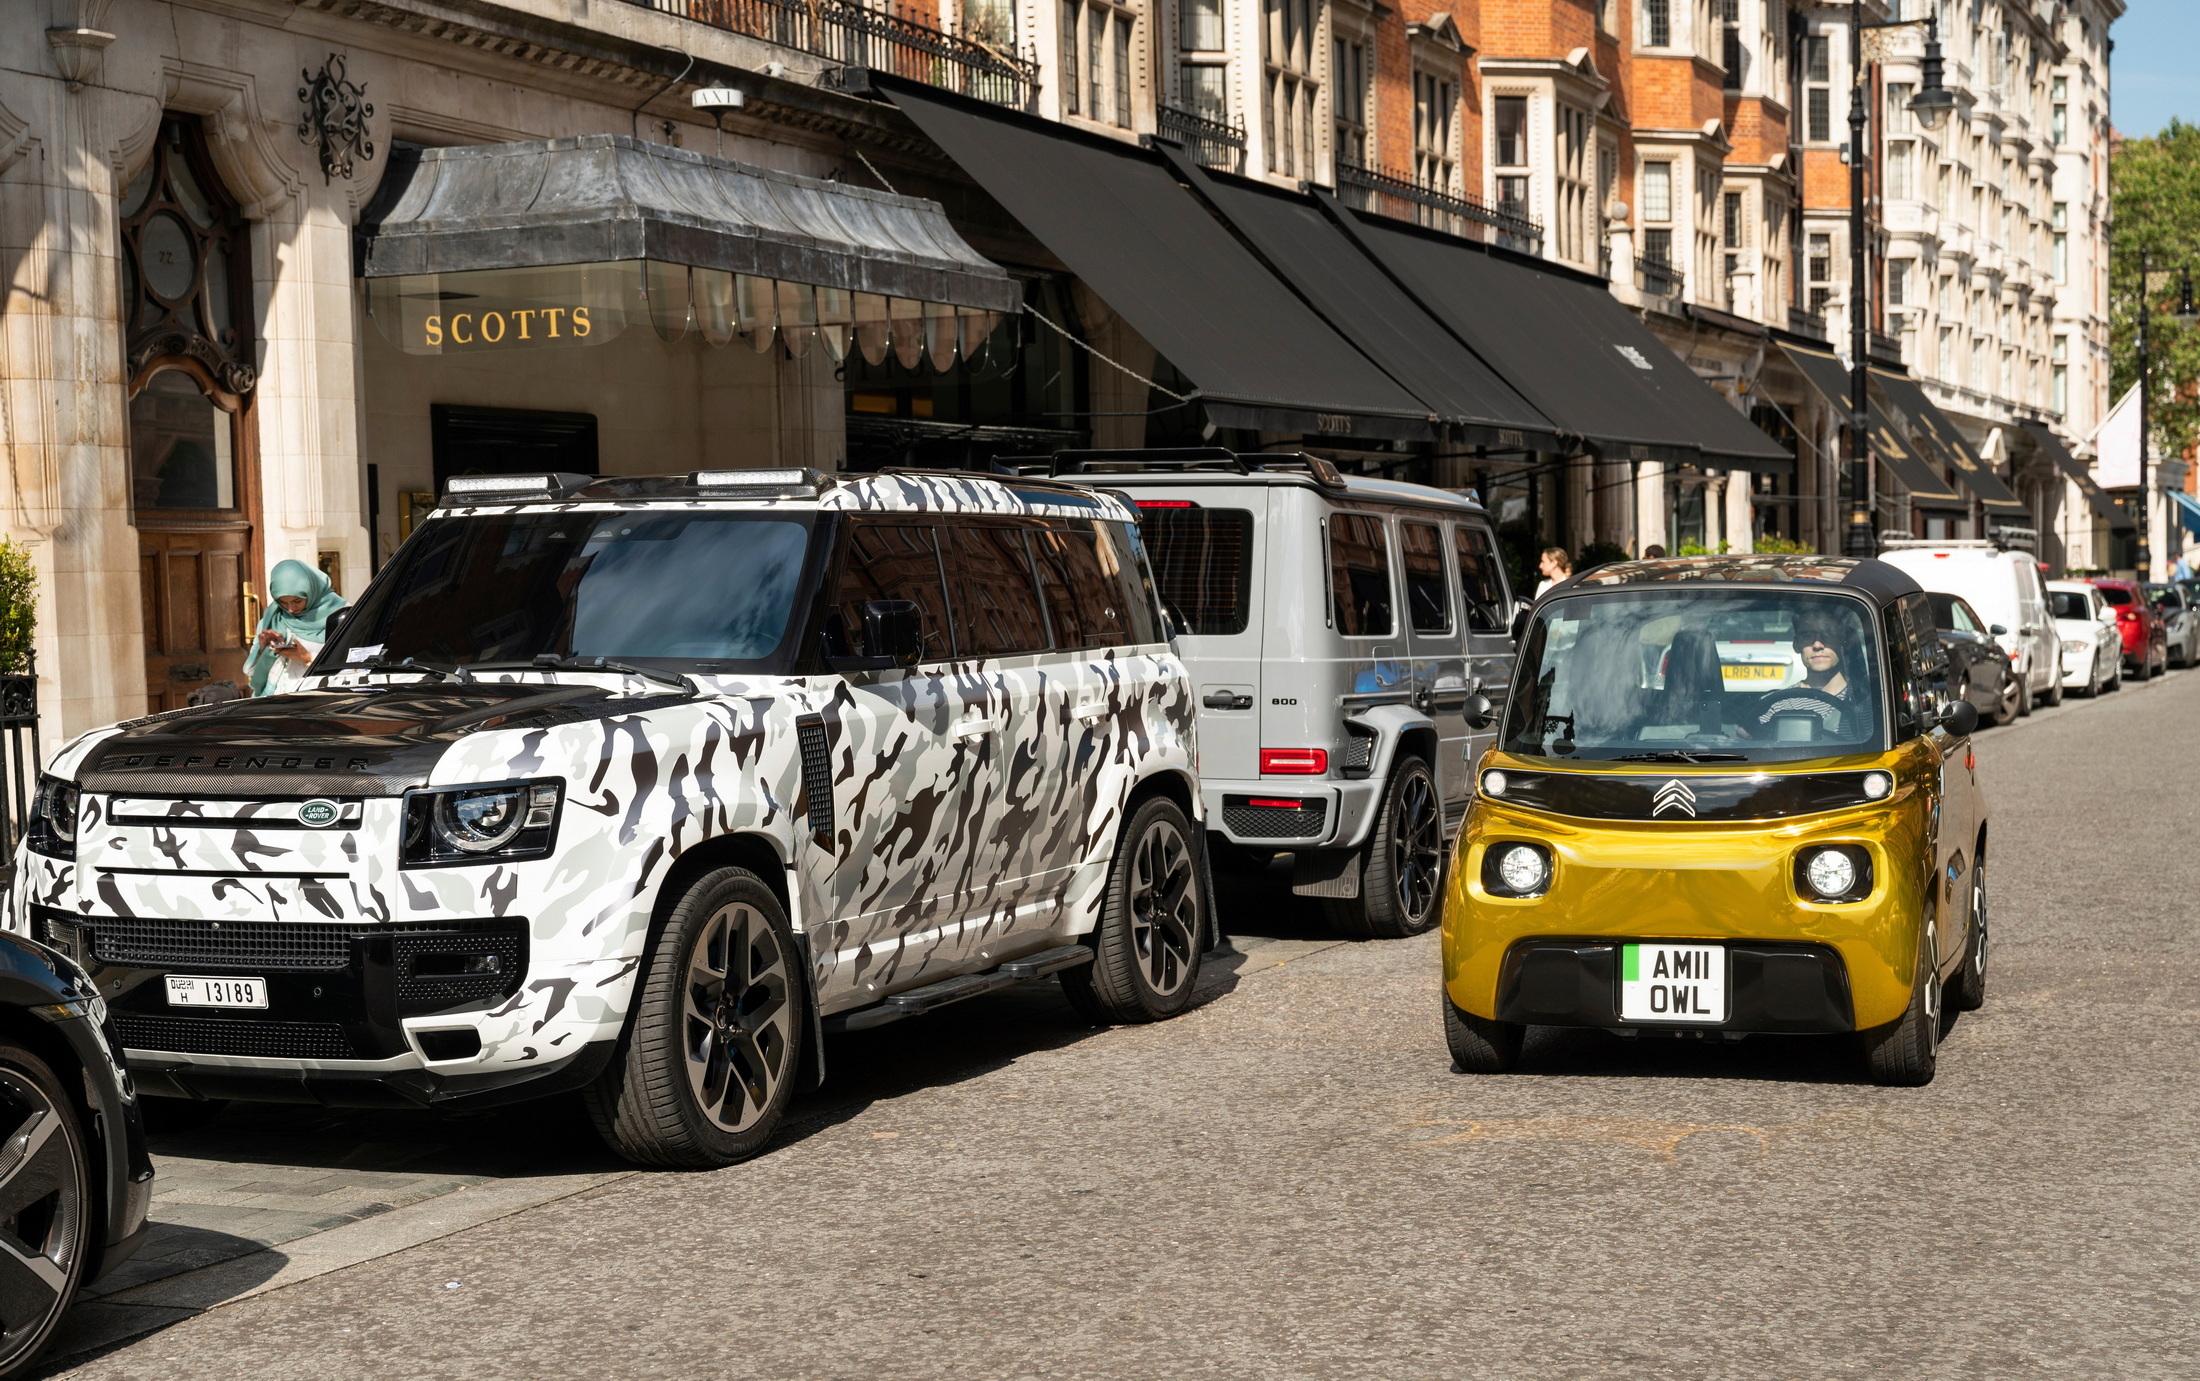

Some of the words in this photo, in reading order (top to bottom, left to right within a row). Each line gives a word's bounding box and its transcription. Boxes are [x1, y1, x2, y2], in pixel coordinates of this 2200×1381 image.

[425, 306, 591, 346] SCOTTS
[1724, 666, 1751, 678] LR19
[124, 756, 370, 770] DEFENDER
[1652, 950, 1709, 980] AM11
[180, 992, 189, 1003] H
[205, 982, 254, 1003] 13189
[1649, 985, 1711, 1015] OWL
